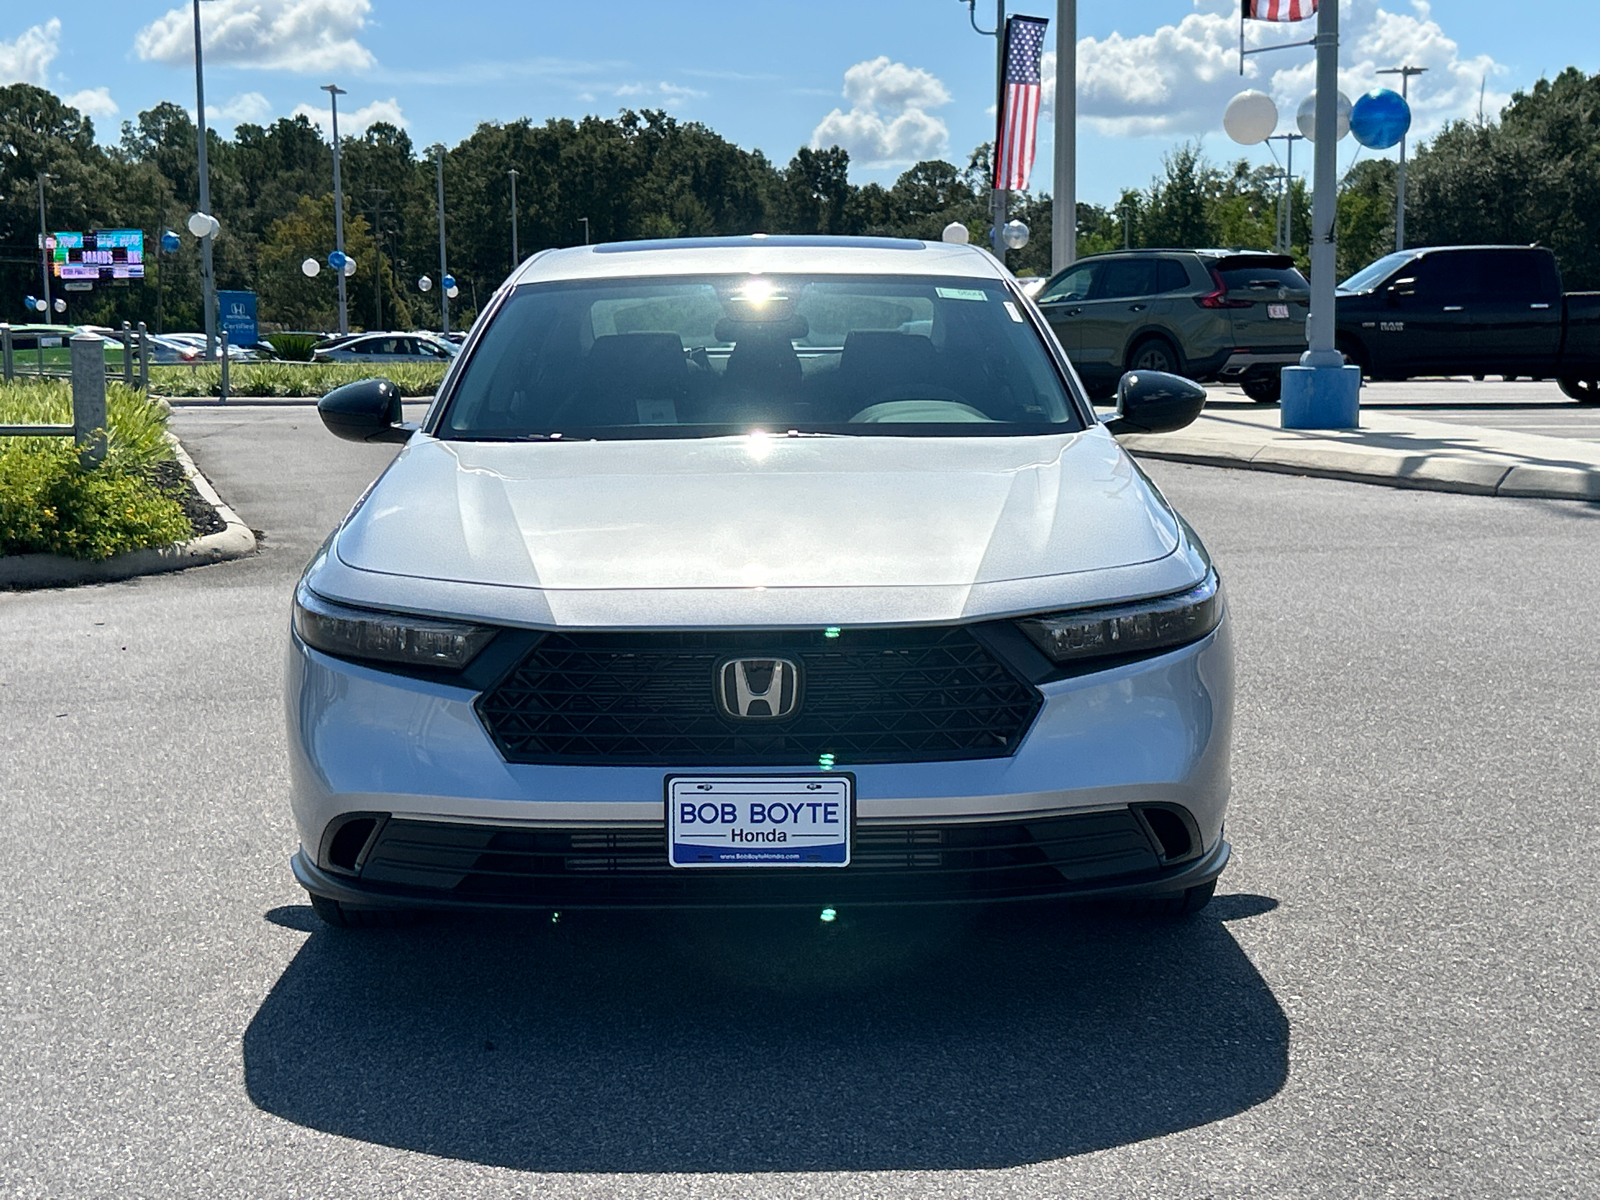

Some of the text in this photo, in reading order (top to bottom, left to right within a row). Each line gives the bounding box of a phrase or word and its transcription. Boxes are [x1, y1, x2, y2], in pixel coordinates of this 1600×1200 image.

[223, 322, 255, 330] Certified
[680, 803, 839, 824] BOB BOYTE
[731, 828, 787, 843] Honda
[720, 853, 800, 861] www.BobBoyteHonda.com
